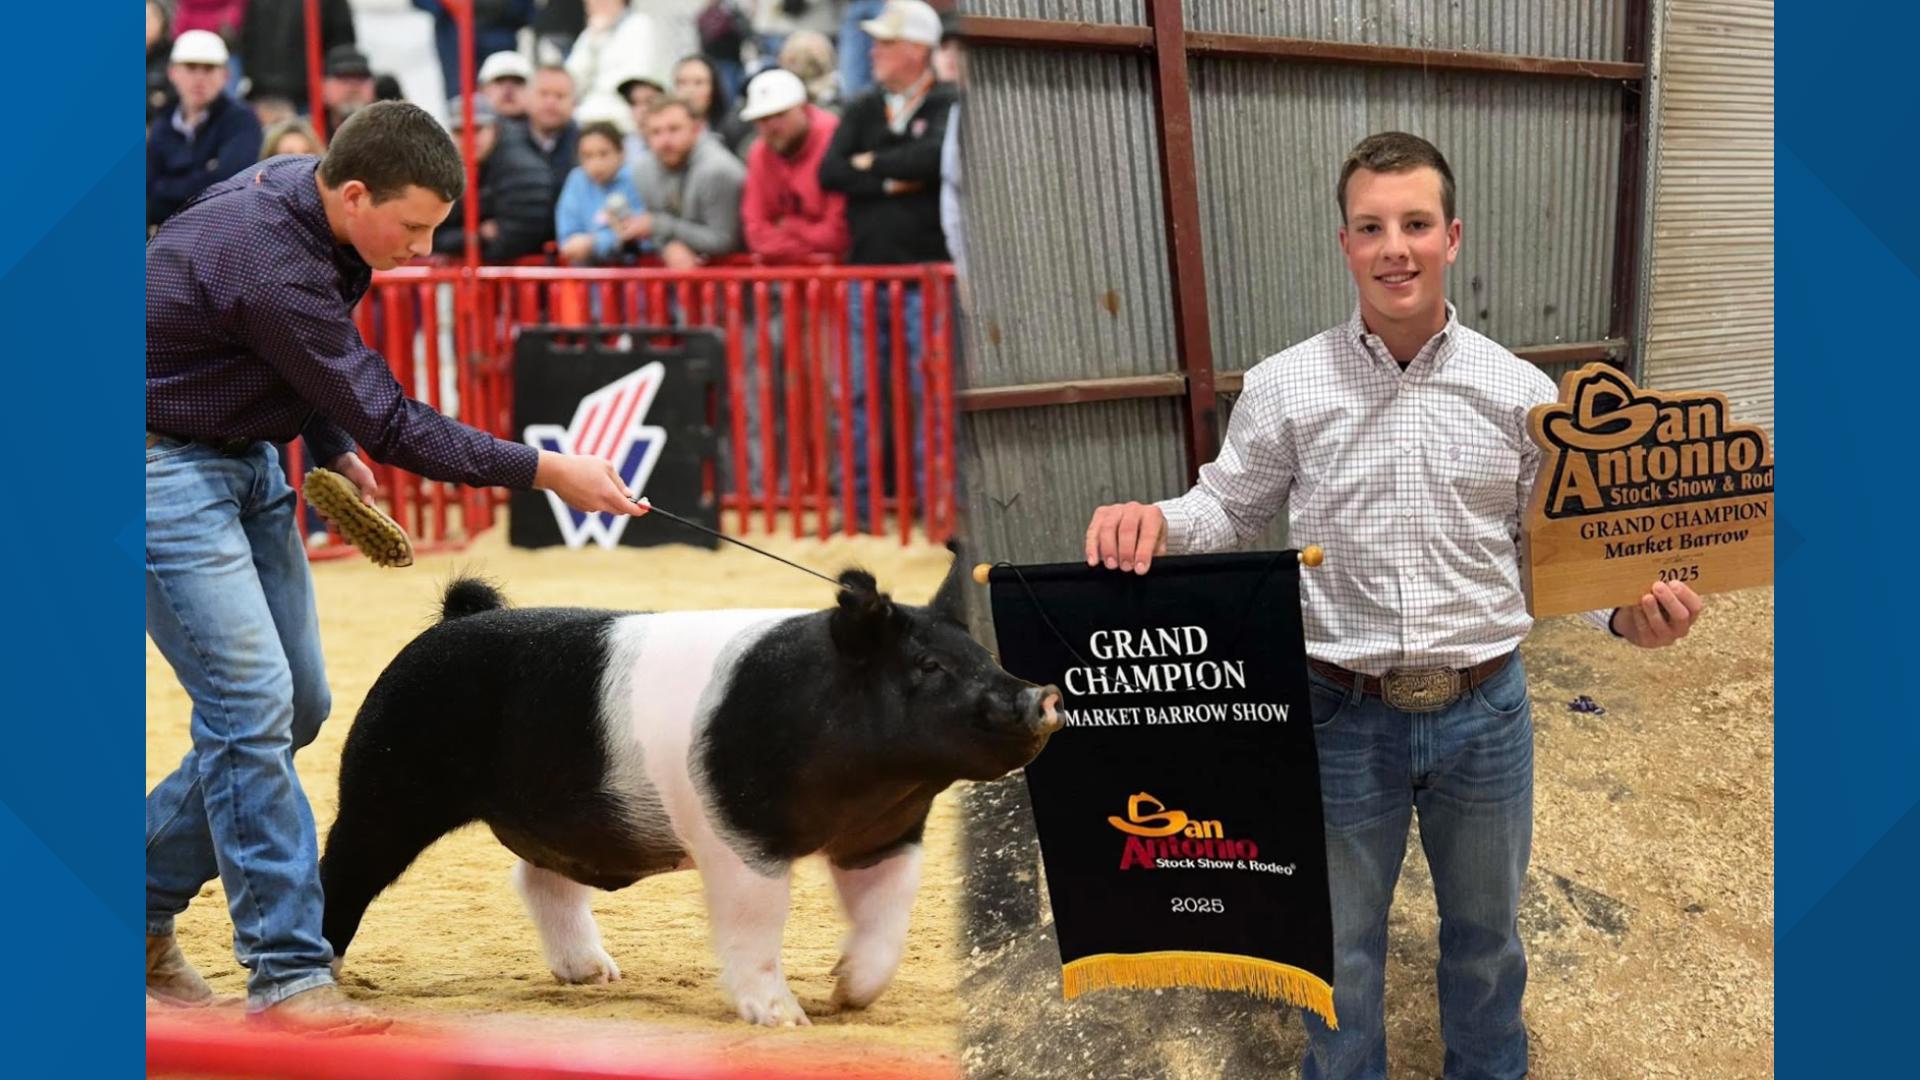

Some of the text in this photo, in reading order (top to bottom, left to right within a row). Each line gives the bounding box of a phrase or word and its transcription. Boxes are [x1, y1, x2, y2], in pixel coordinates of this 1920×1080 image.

[1550, 375, 1717, 448] San
[1552, 437, 1757, 513] Antonio
[1610, 483, 1661, 505] Stock
[1668, 477, 1716, 499] Show
[1723, 475, 1734, 492] &
[1580, 501, 1768, 540] GRAND CHAMPION
[1603, 529, 1749, 560] Market Barrow
[1658, 565, 1699, 583] 2025
[1089, 625, 1208, 660] GRAND
[1064, 660, 1246, 696] CHAMPION
[1065, 703, 1290, 728] MARKET BARROW SHOW
[1107, 791, 1224, 838] San
[1119, 836, 1259, 871] Antonio
[1156, 857, 1195, 869] Stock
[1197, 858, 1234, 870] Show
[1236, 860, 1248, 870] &
[1171, 897, 1225, 914] 2025
